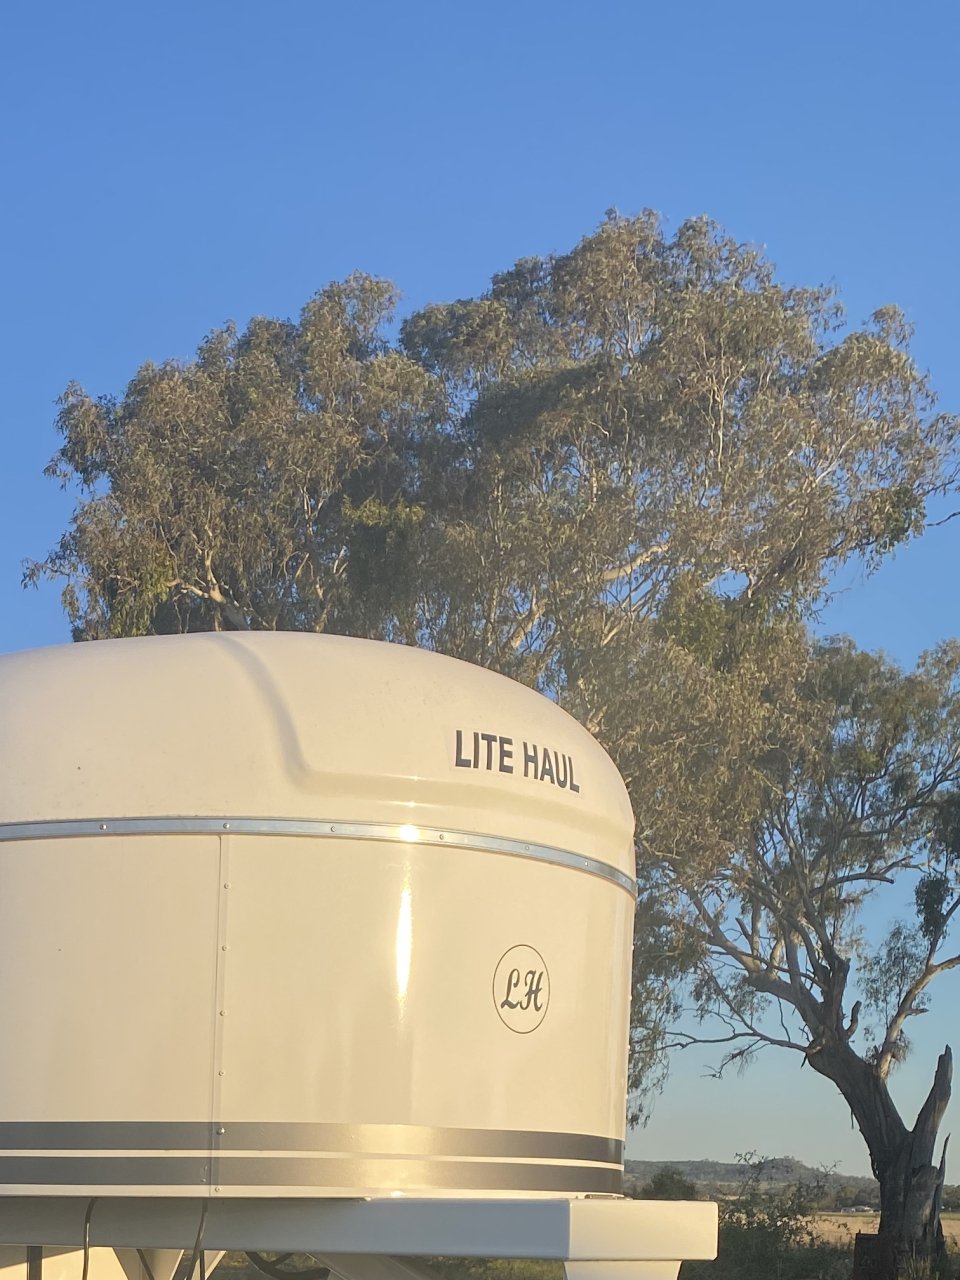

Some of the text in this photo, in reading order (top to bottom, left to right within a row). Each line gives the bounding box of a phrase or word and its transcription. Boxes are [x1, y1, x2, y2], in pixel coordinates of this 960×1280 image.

[455, 730, 580, 793] LITE HAUL
[501, 968, 544, 1012] LH
